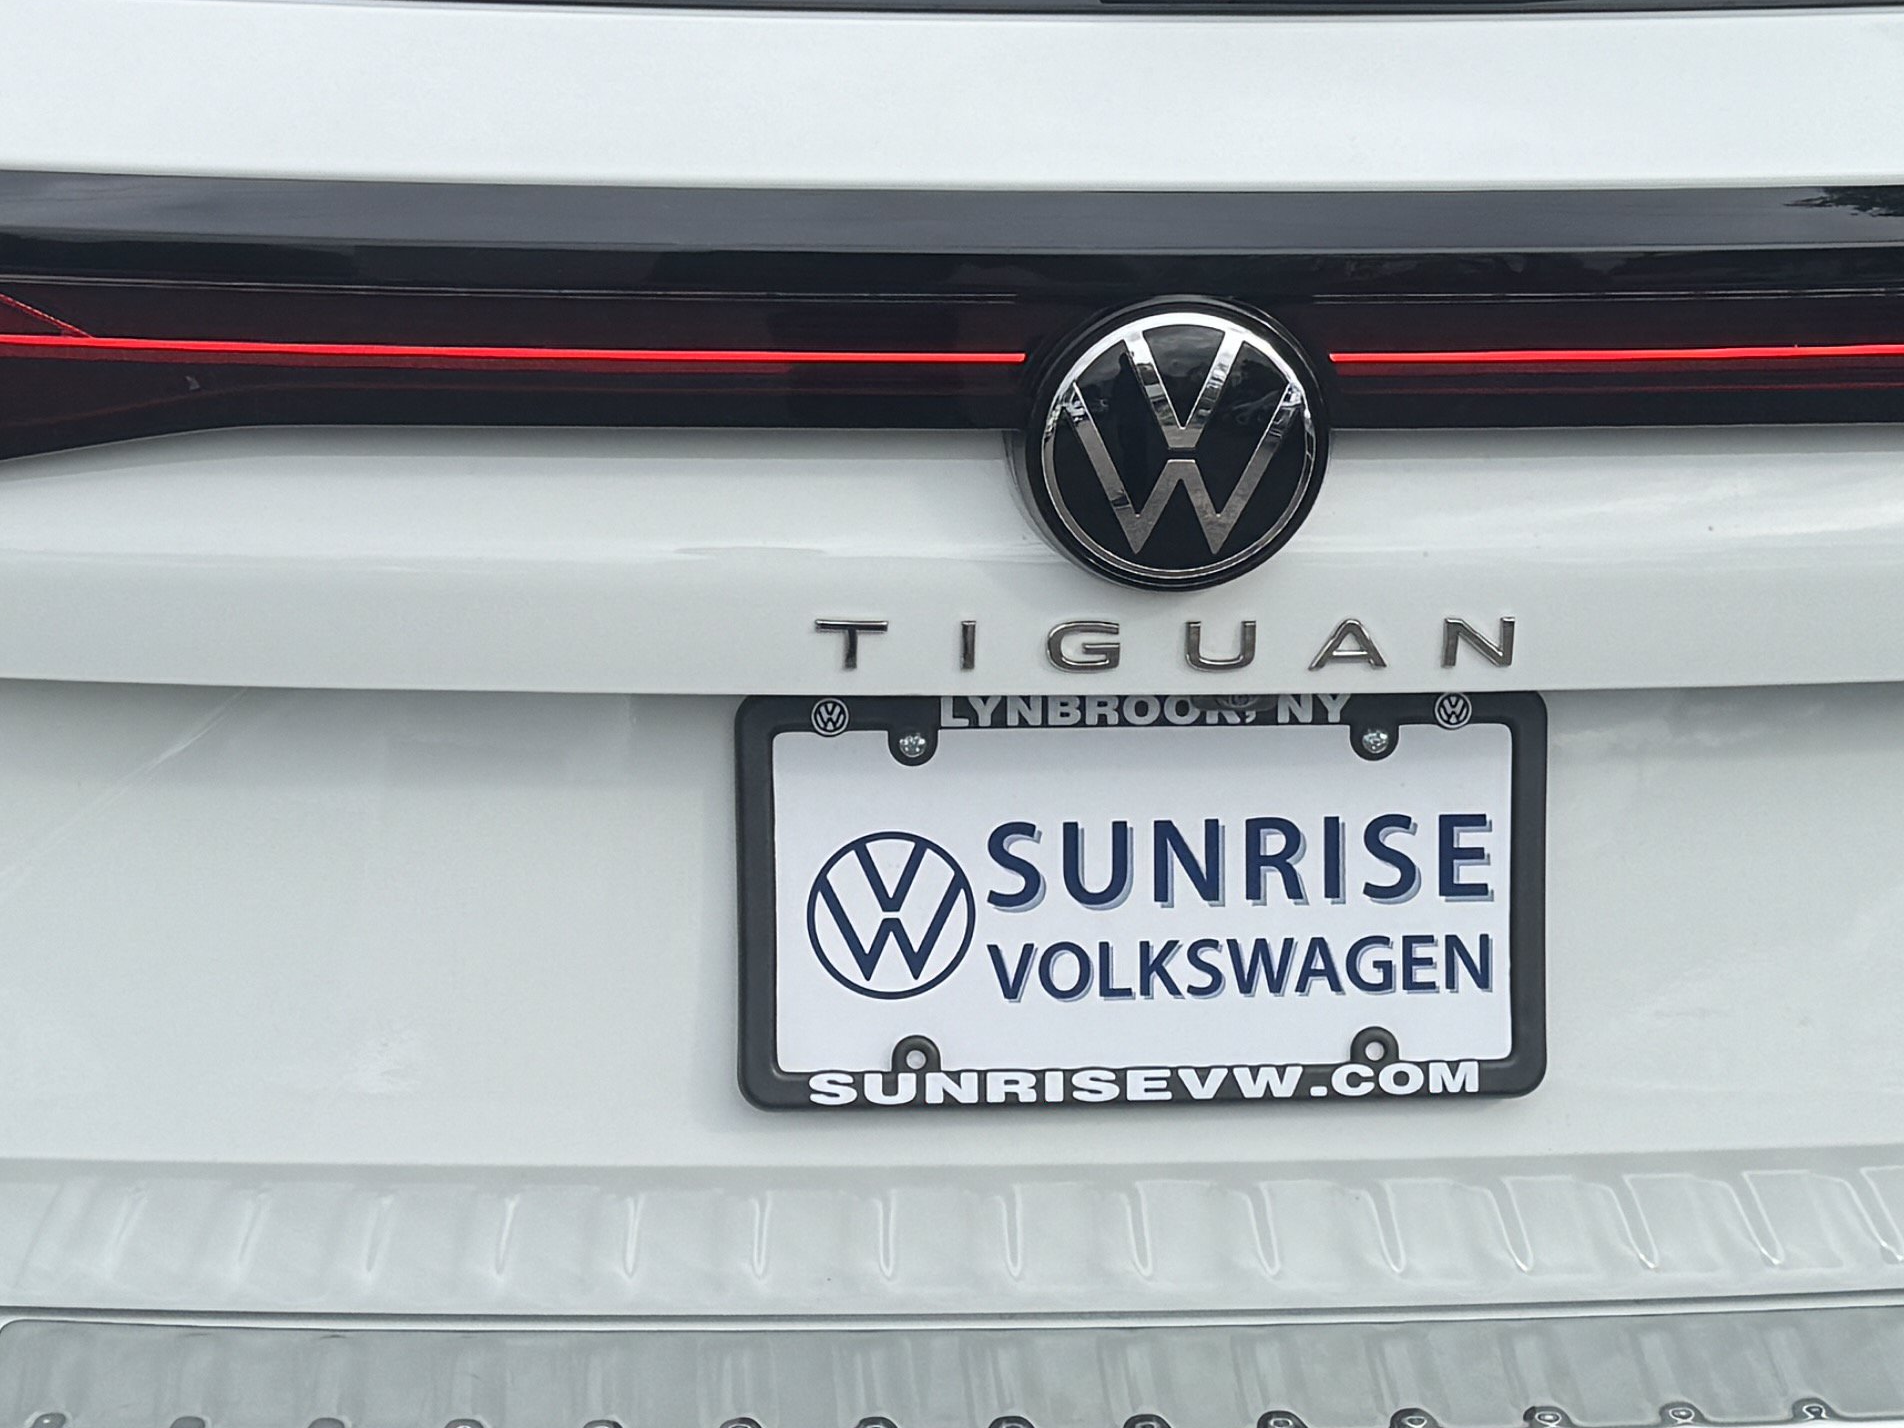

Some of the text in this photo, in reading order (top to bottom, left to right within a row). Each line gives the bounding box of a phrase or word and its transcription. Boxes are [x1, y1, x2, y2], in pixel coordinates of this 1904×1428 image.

[814, 617, 1517, 671] TIGUAN
[1276, 693, 1351, 725] NY
[986, 813, 1495, 913] SUNRISE
[986, 932, 1493, 1005] VOLKSWAGEN
[808, 1061, 1480, 1107] SUNRISEVW.COM
